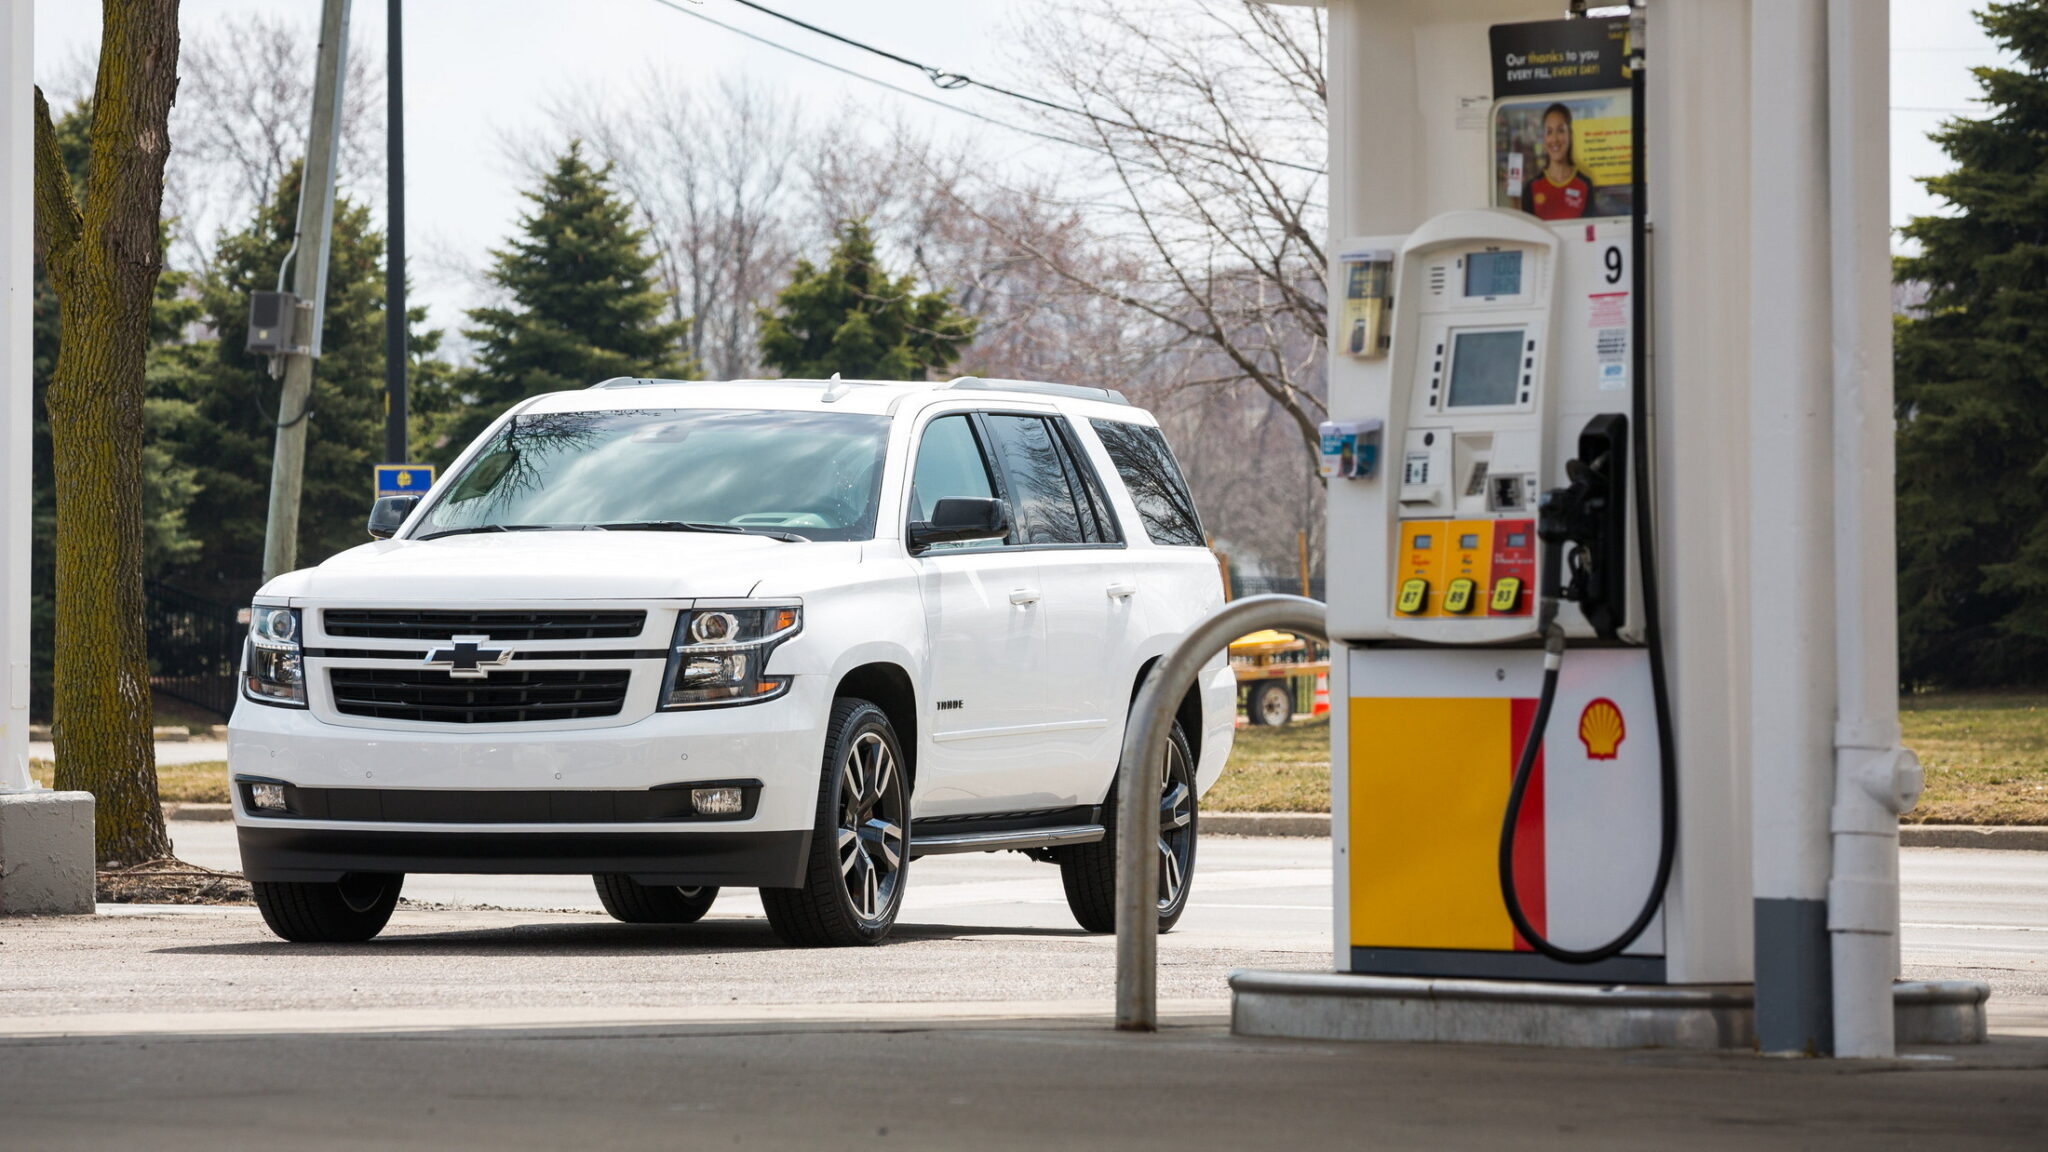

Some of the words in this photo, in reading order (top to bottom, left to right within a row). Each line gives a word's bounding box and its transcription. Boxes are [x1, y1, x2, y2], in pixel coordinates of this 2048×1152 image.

[1505, 53, 1526, 67] Our
[1527, 49, 1564, 65] thanks
[1565, 50, 1577, 62] to
[1579, 50, 1599, 63] you
[1506, 69, 1533, 81] EVERY
[1552, 65, 1578, 78] EVERY
[1604, 245, 1623, 285] 9
[1403, 591, 1418, 604] 87
[1449, 591, 1465, 603] 89
[1497, 589, 1511, 602] 93
